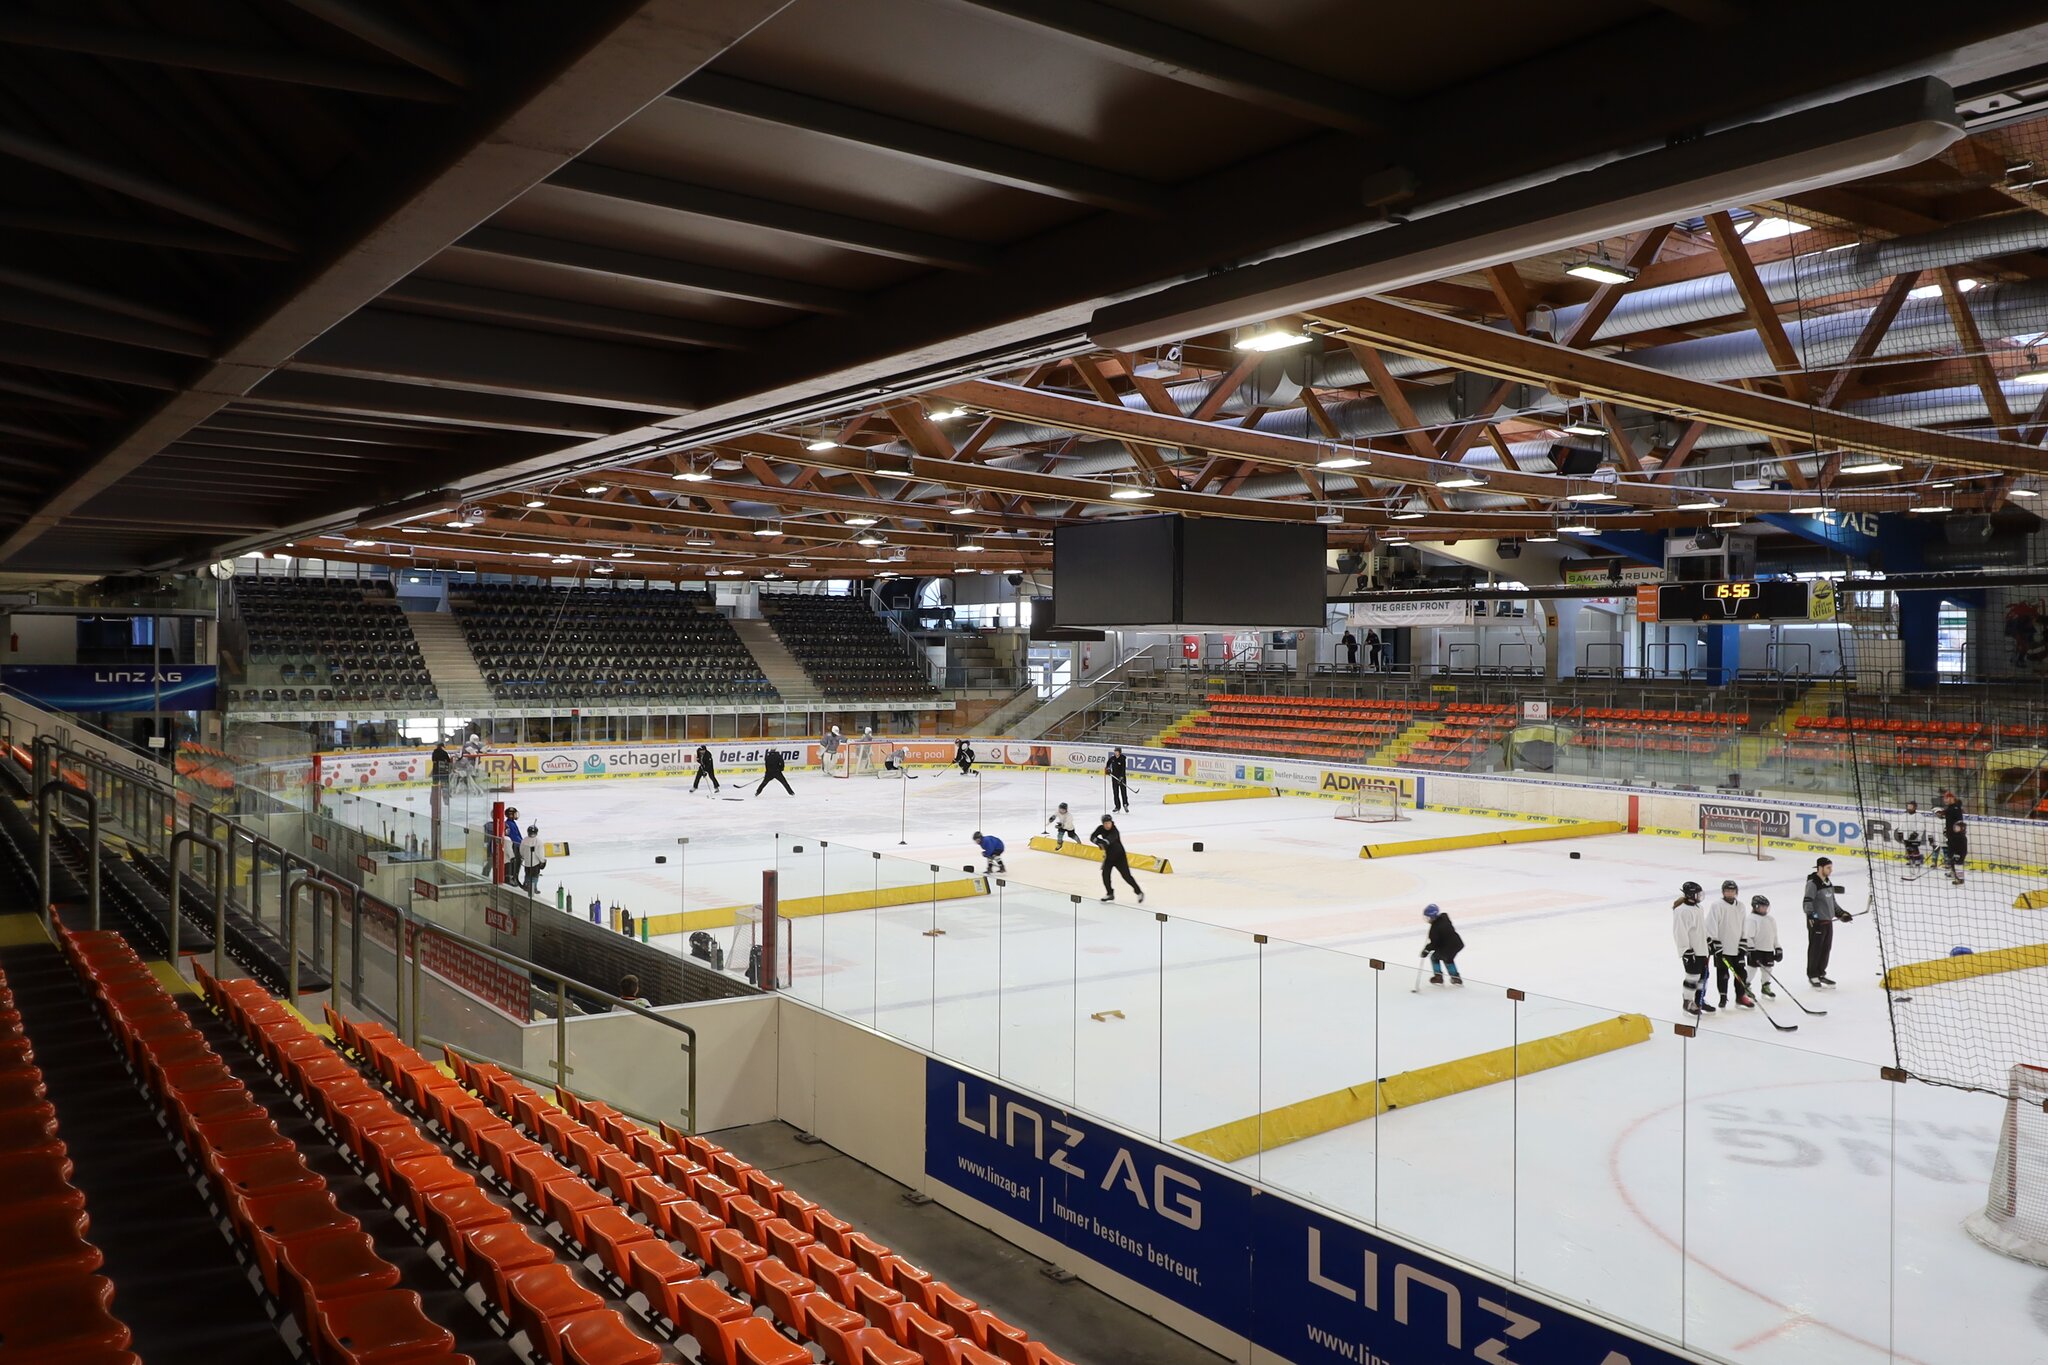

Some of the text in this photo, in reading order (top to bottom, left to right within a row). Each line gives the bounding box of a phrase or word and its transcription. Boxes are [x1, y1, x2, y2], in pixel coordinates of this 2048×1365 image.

[1372, 602, 1450, 612] THE GREEN FRONT
[95, 672, 182, 682] LINZ AG
[610, 750, 681, 768] schagerl
[924, 750, 945, 760] pool
[1150, 758, 1172, 772] AG
[1750, 810, 1788, 825] GOLD
[1656, 828, 1681, 836] greiner
[1768, 840, 1796, 848] greiner
[1808, 844, 1836, 852] greiner
[958, 1081, 1202, 1231] LINZ AG
[958, 1154, 1031, 1202] www.linzag.at
[1052, 1198, 1202, 1287] Immer bestens betreut.
[1308, 1226, 1542, 1365] LINZ
